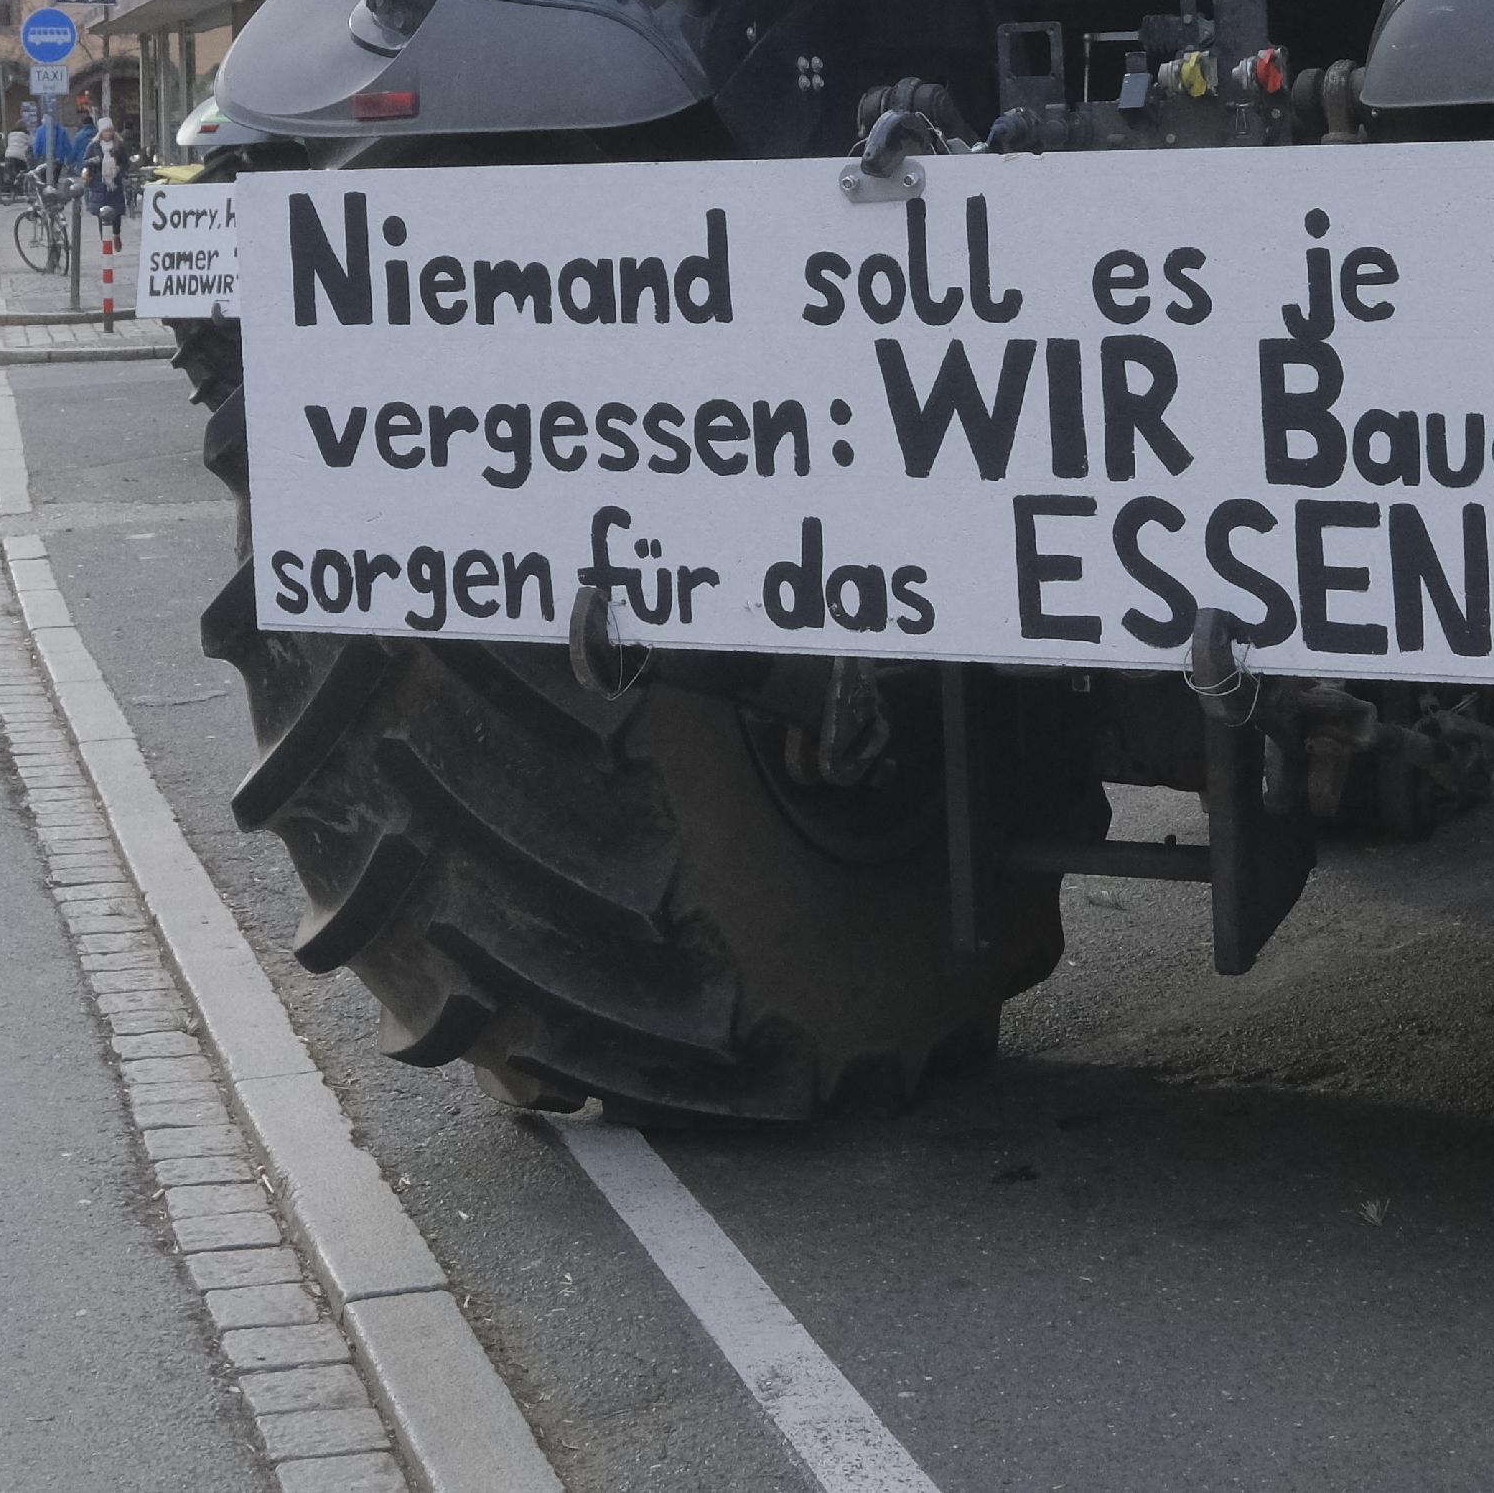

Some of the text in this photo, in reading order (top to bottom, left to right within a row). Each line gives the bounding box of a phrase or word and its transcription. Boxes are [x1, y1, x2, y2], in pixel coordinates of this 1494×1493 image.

[36, 70, 63, 82] TAXI
[152, 190, 221, 231] Sorry,
[150, 249, 220, 272] samer
[289, 191, 1400, 341] Niemand soll es je
[149, 273, 239, 296] LANDWIR
[305, 398, 856, 489] vergessen:
[874, 334, 1195, 482] WIR
[271, 494, 1493, 658] sorgen für das ESSEN
